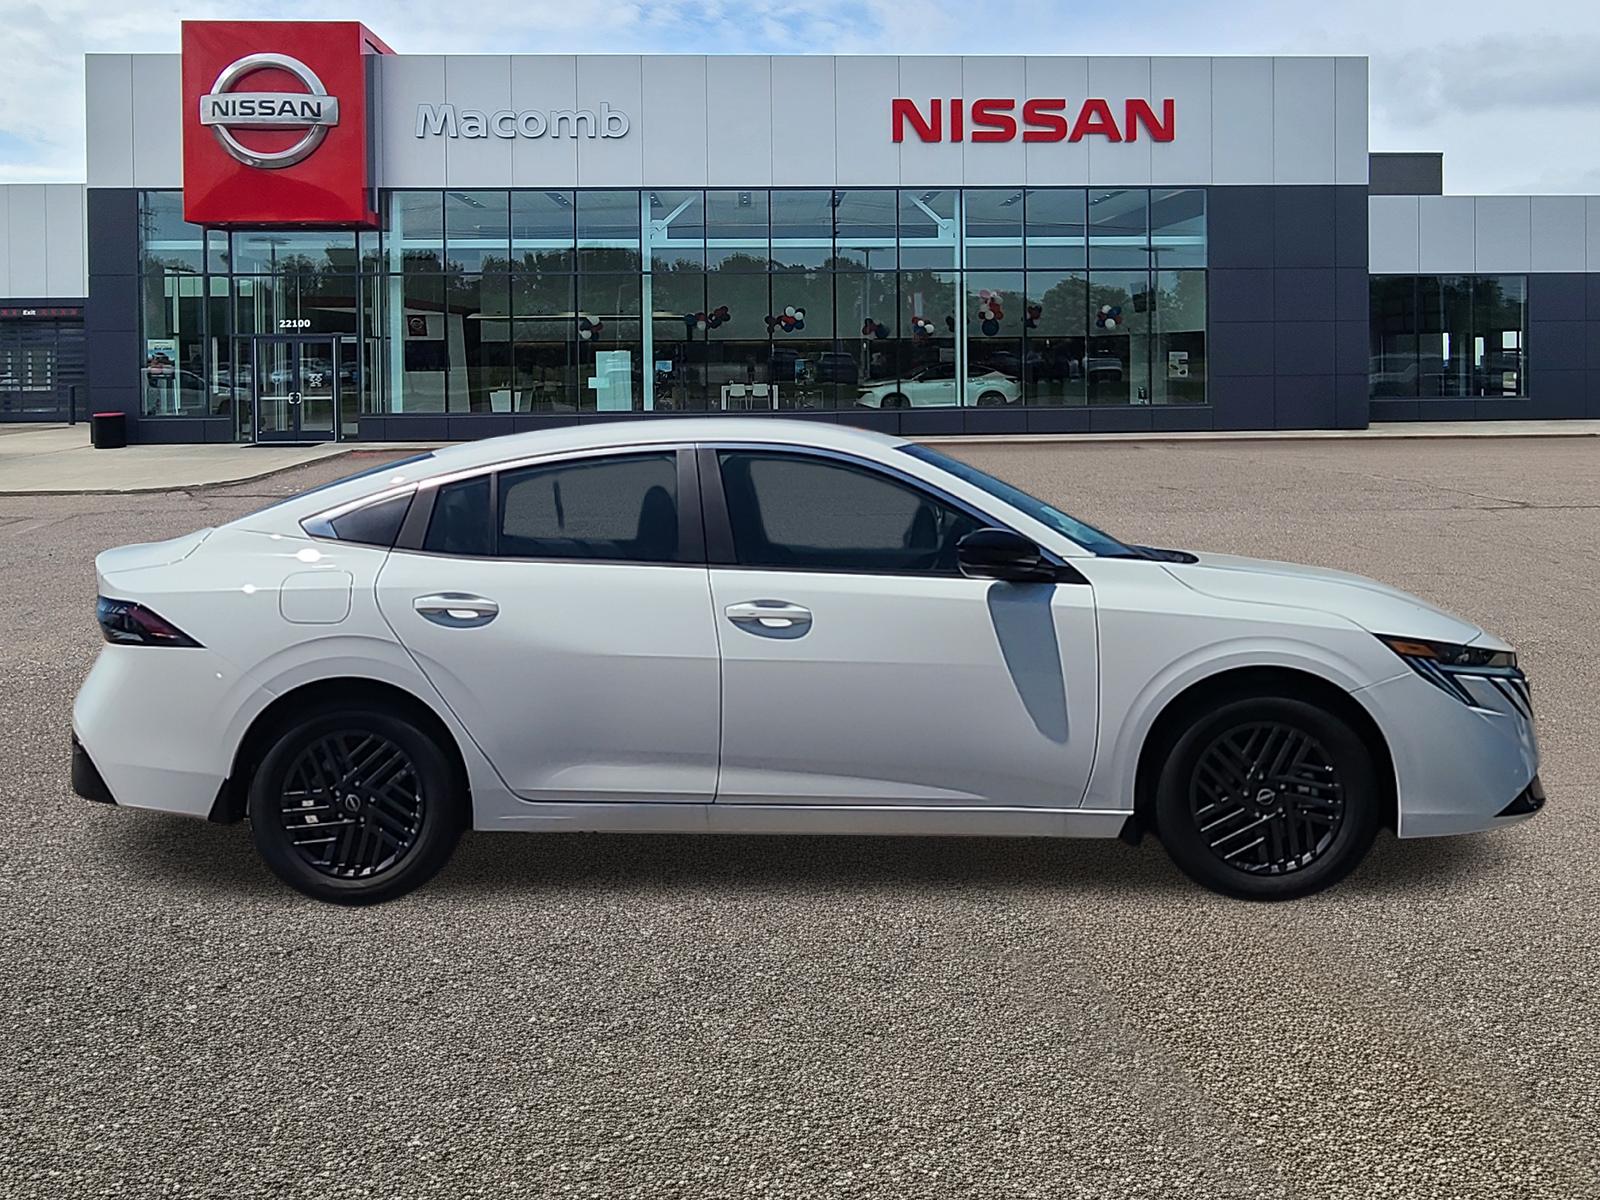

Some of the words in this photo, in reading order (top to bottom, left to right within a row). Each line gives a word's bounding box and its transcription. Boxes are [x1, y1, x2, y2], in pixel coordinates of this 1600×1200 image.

[211, 100, 322, 118] NISSAN
[415, 102, 631, 139] Macomb
[892, 98, 1176, 143] NISSAN
[279, 319, 311, 328] 22100
